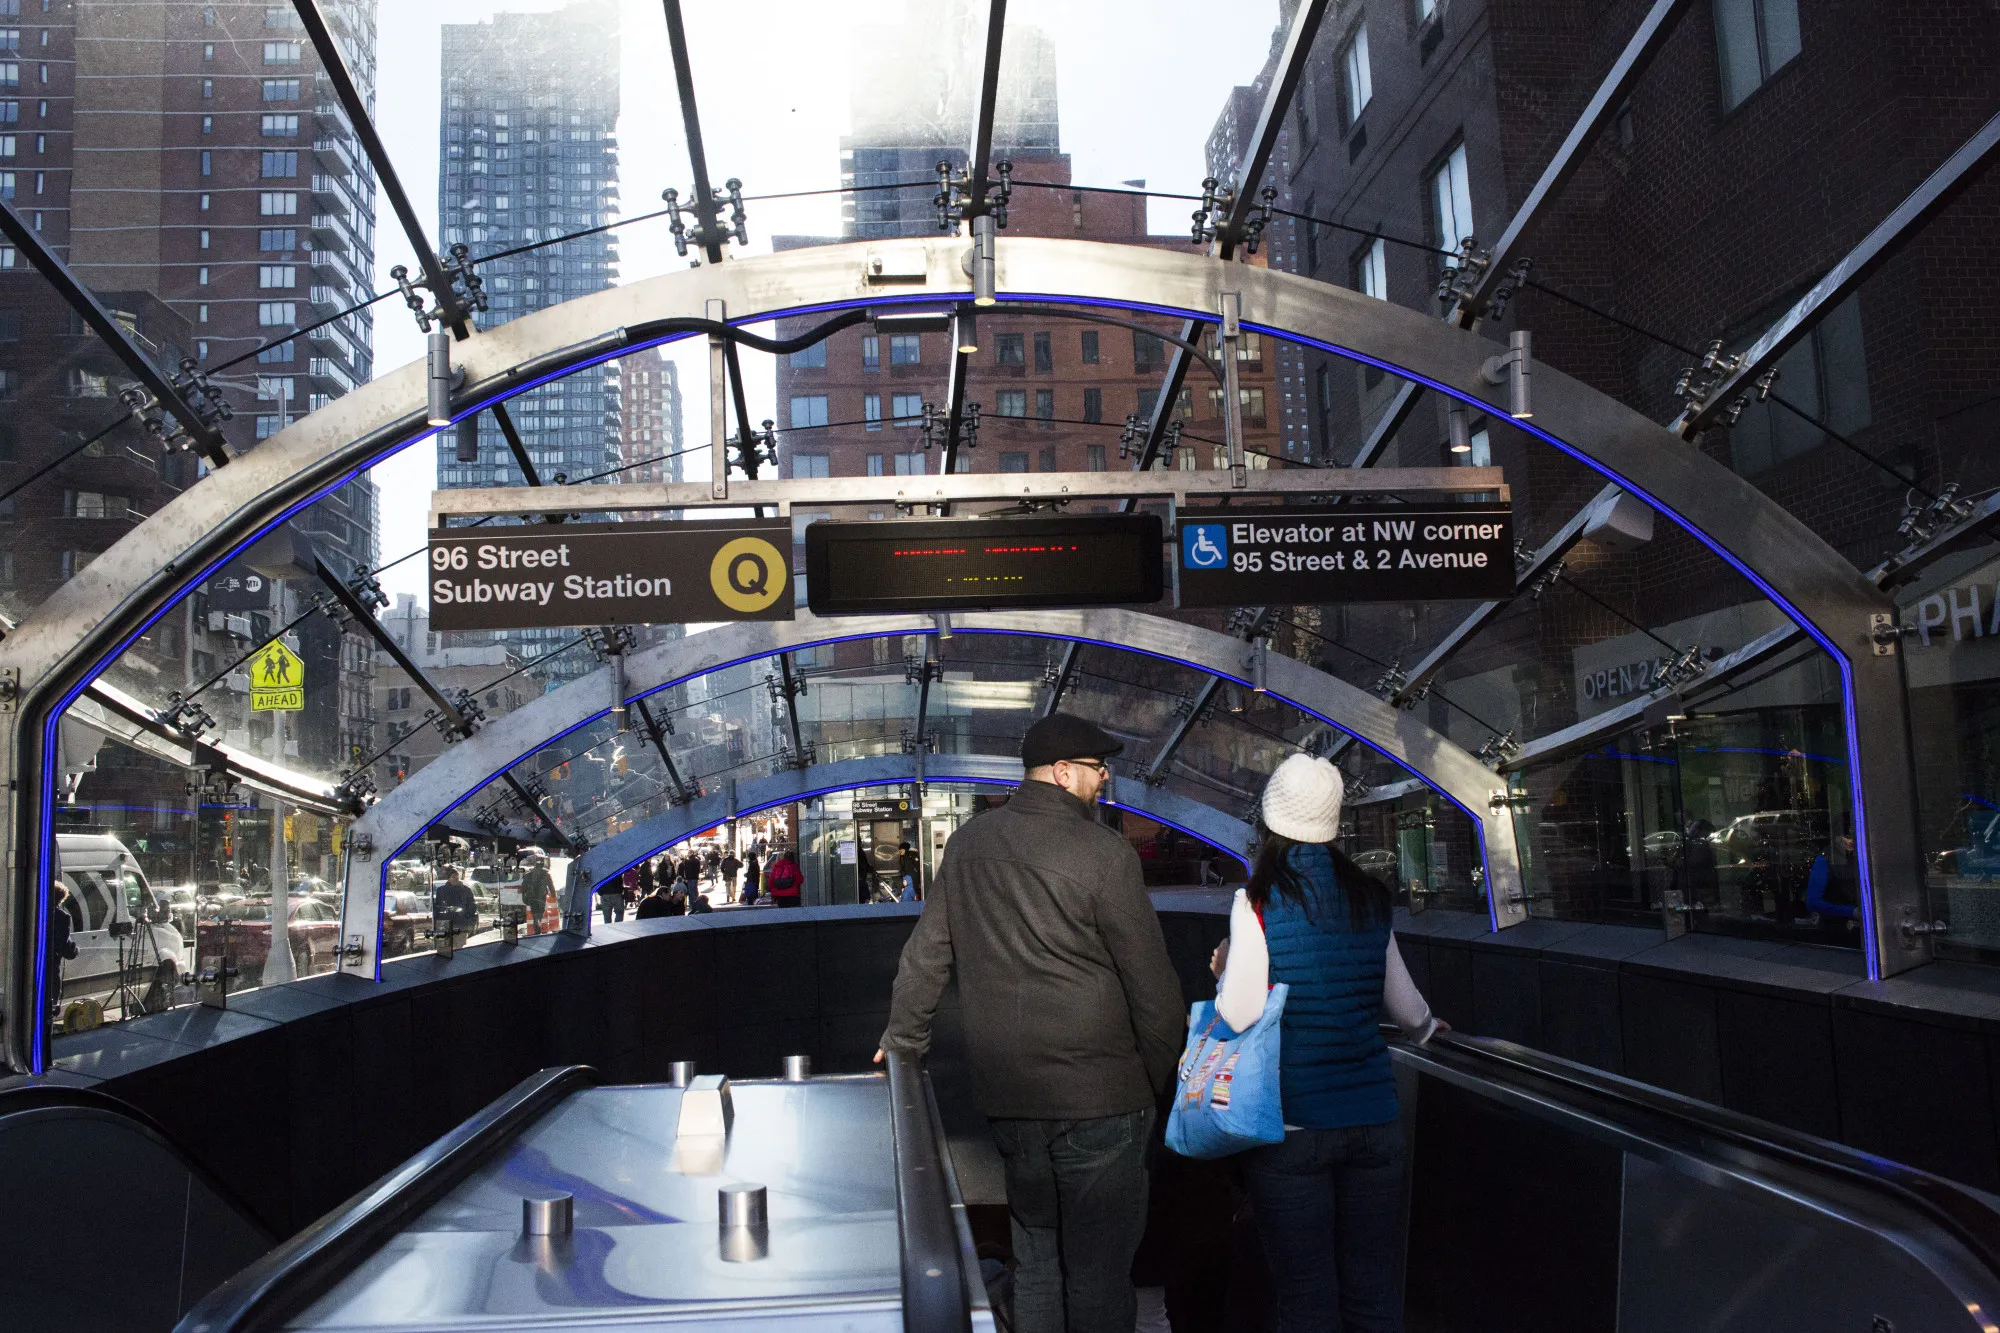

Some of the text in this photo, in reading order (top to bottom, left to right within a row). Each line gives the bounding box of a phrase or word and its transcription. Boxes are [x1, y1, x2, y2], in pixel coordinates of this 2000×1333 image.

[1232, 520, 1504, 545] Elevator at NW corner
[432, 544, 570, 571] 96 Street
[1233, 549, 1488, 573] 95 Street & 2 Avenue
[728, 552, 769, 597] Q
[433, 574, 672, 605] Subway Station
[1583, 665, 1633, 700] OPEN
[257, 693, 298, 707] AHEAD
